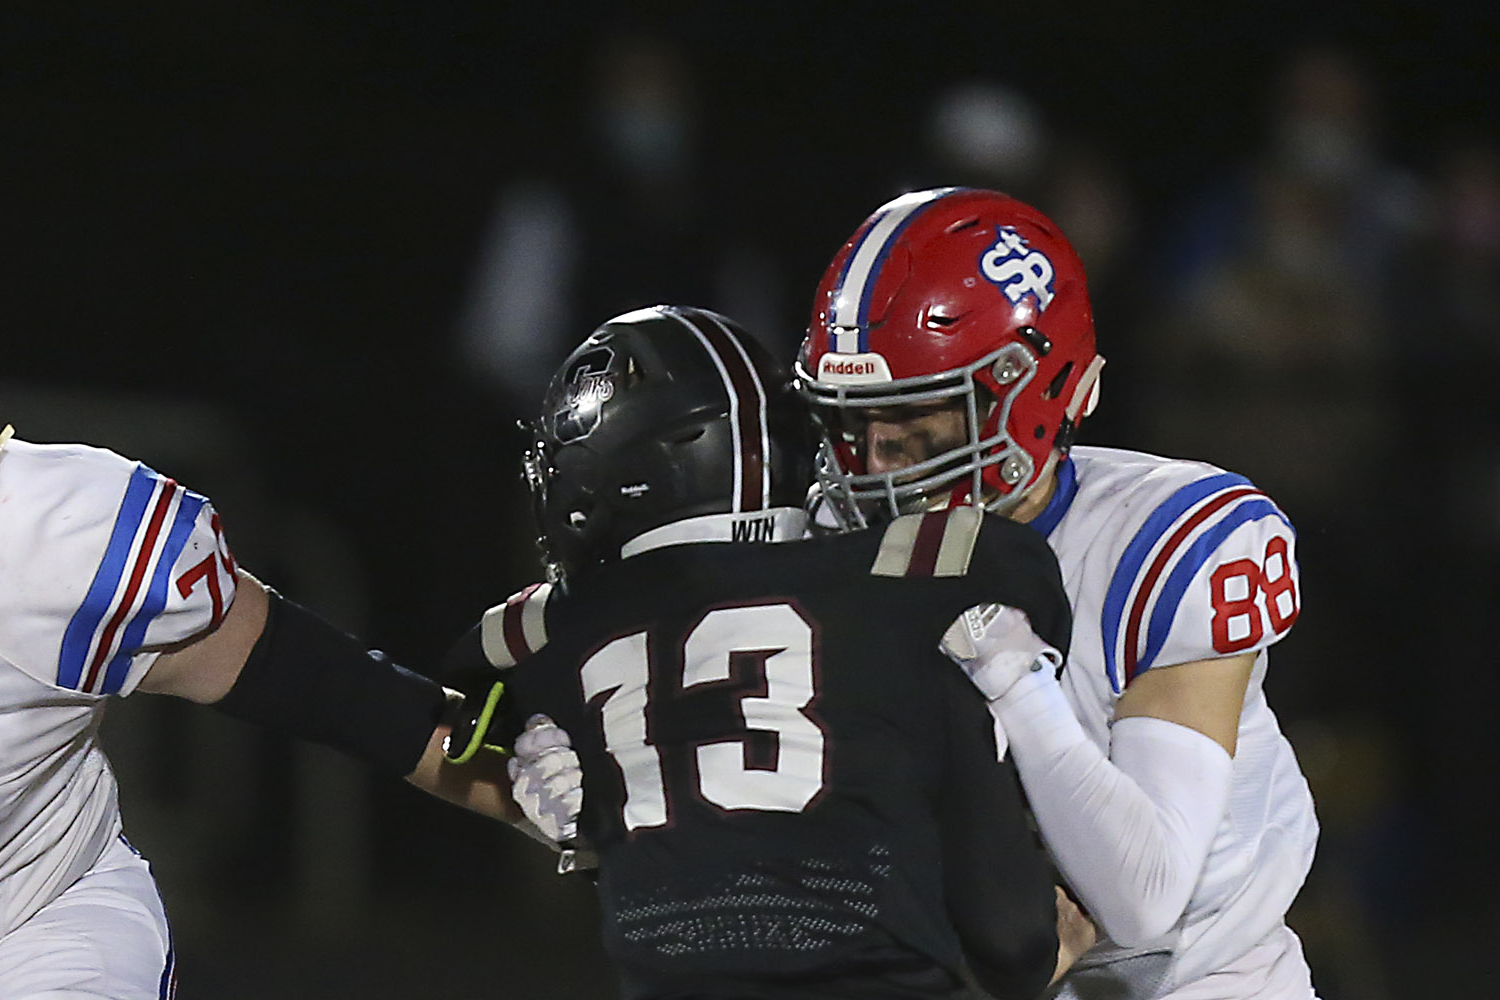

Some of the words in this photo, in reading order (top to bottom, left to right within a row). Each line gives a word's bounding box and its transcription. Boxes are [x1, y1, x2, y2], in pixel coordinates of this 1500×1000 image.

[823, 361, 875, 375] Riddell
[1209, 535, 1301, 655] 88
[578, 603, 825, 833] 13
